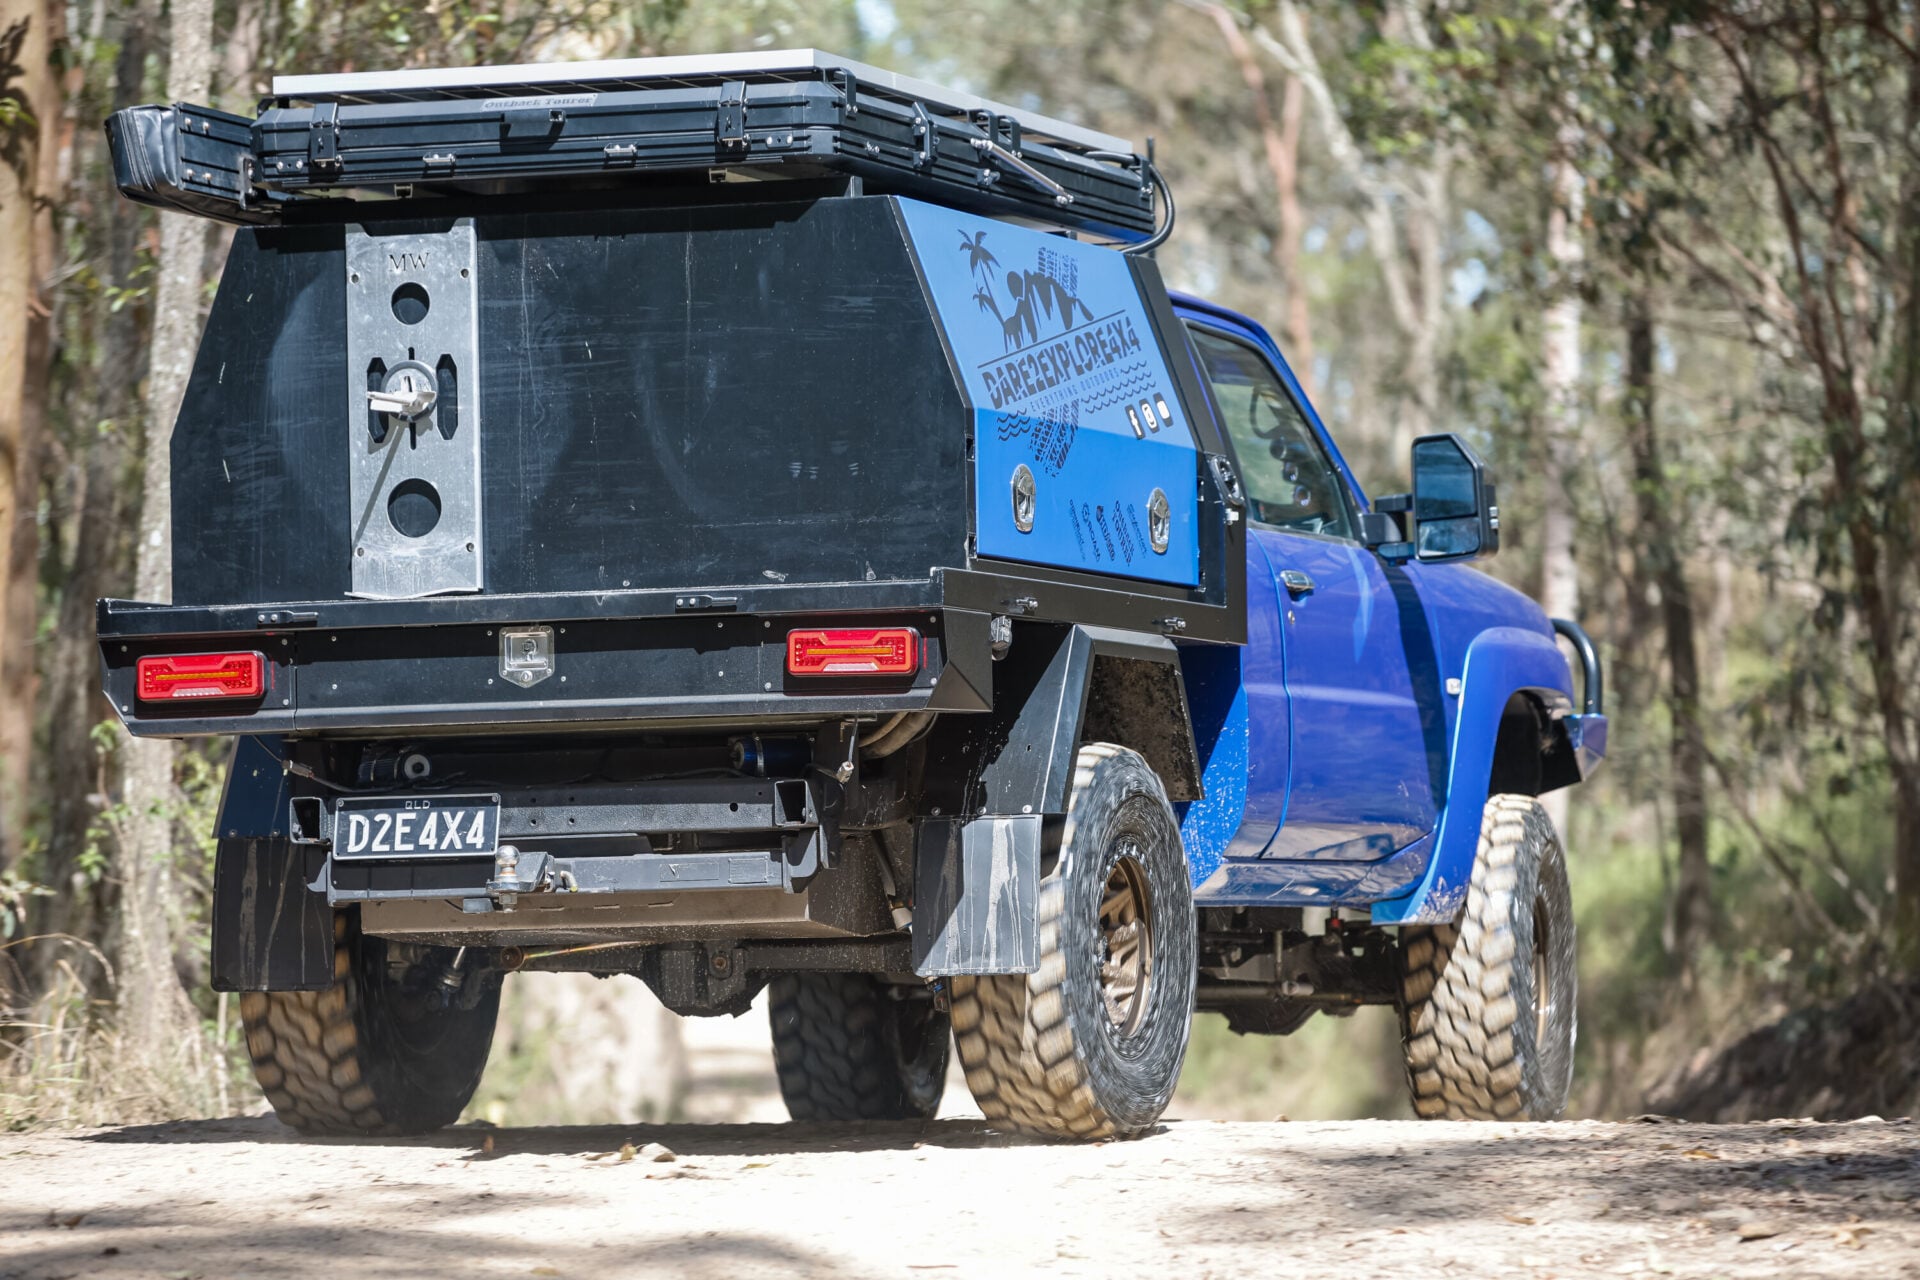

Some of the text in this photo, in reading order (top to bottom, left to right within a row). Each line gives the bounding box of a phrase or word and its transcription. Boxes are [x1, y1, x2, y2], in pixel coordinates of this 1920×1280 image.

[389, 252, 430, 271] MW
[982, 316, 1141, 410] DARE2EXPLORE4X4
[405, 800, 431, 810] QLD
[347, 810, 485, 853] D2E4X4
